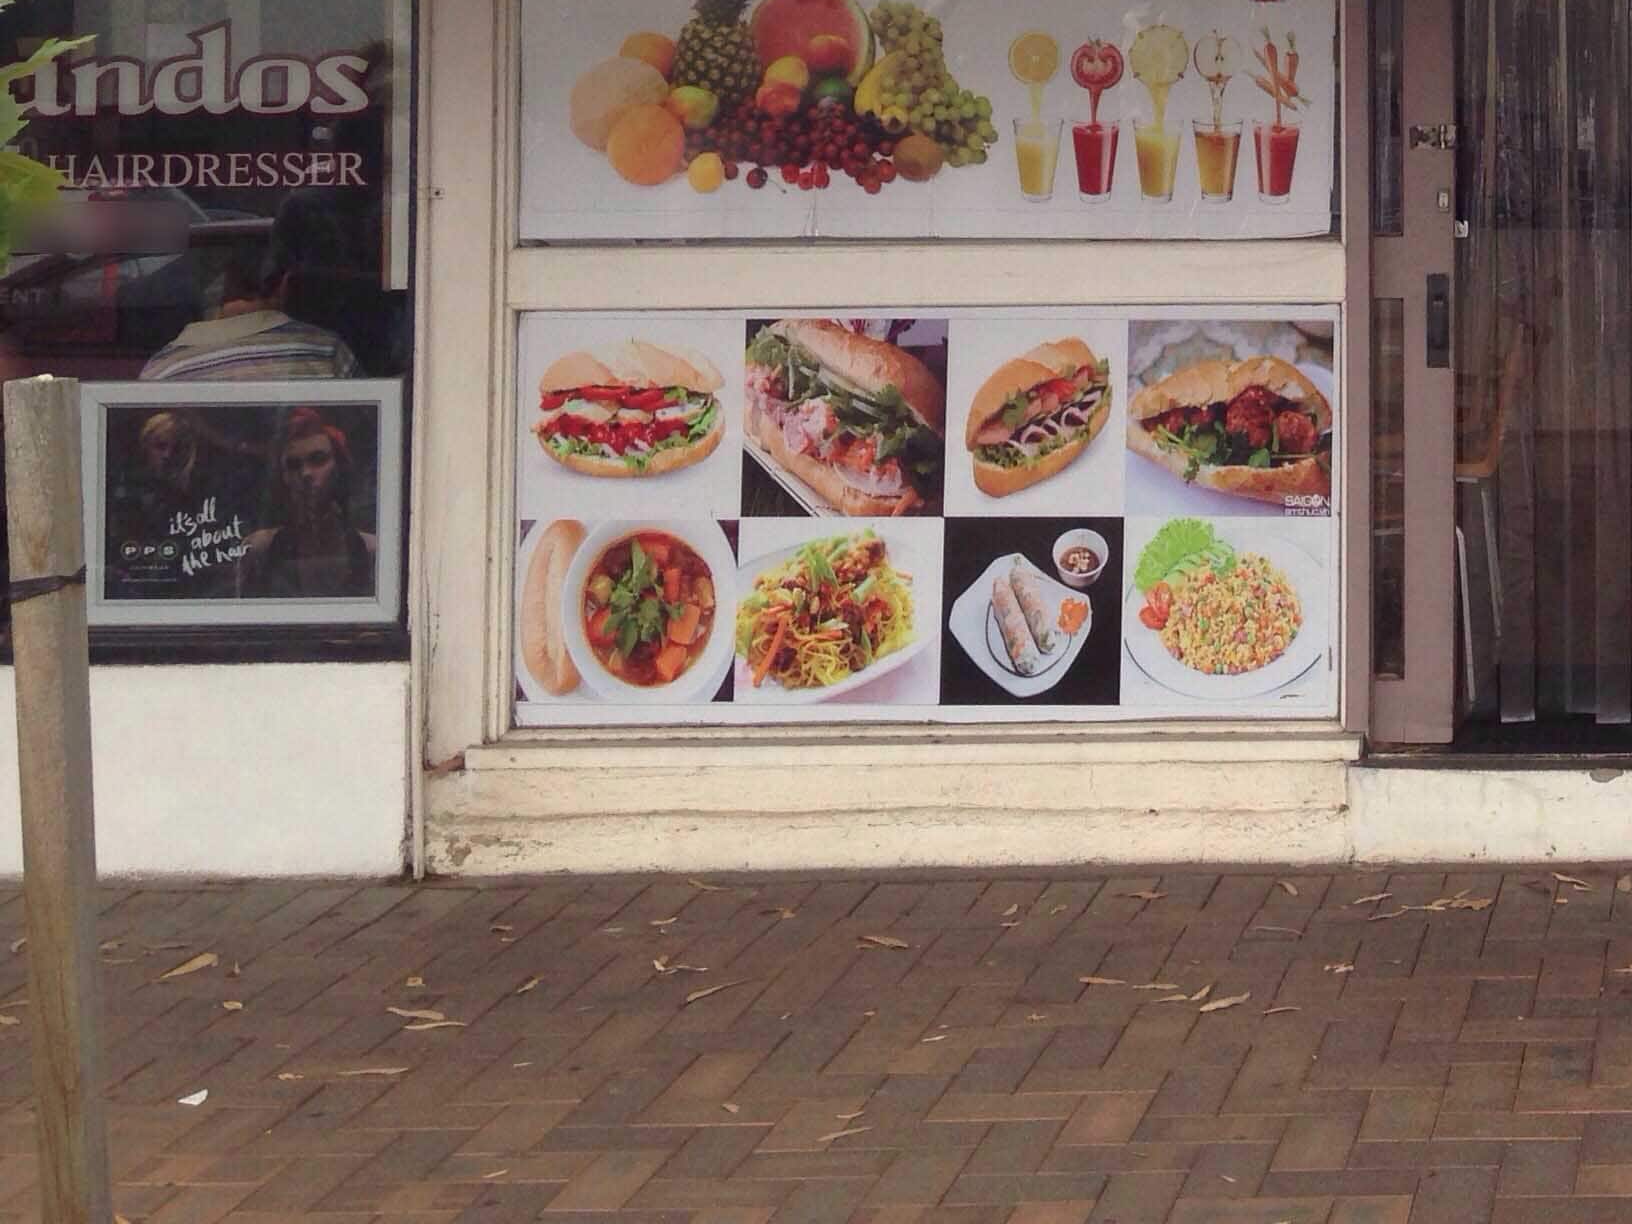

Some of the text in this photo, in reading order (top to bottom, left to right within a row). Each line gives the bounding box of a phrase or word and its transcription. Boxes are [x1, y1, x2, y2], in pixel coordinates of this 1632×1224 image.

[49, 151, 368, 188] HAIRDRESSER
[169, 496, 217, 537] it's all
[1284, 494, 1330, 507] SAIGON
[191, 514, 243, 550] about
[182, 551, 212, 576] the
